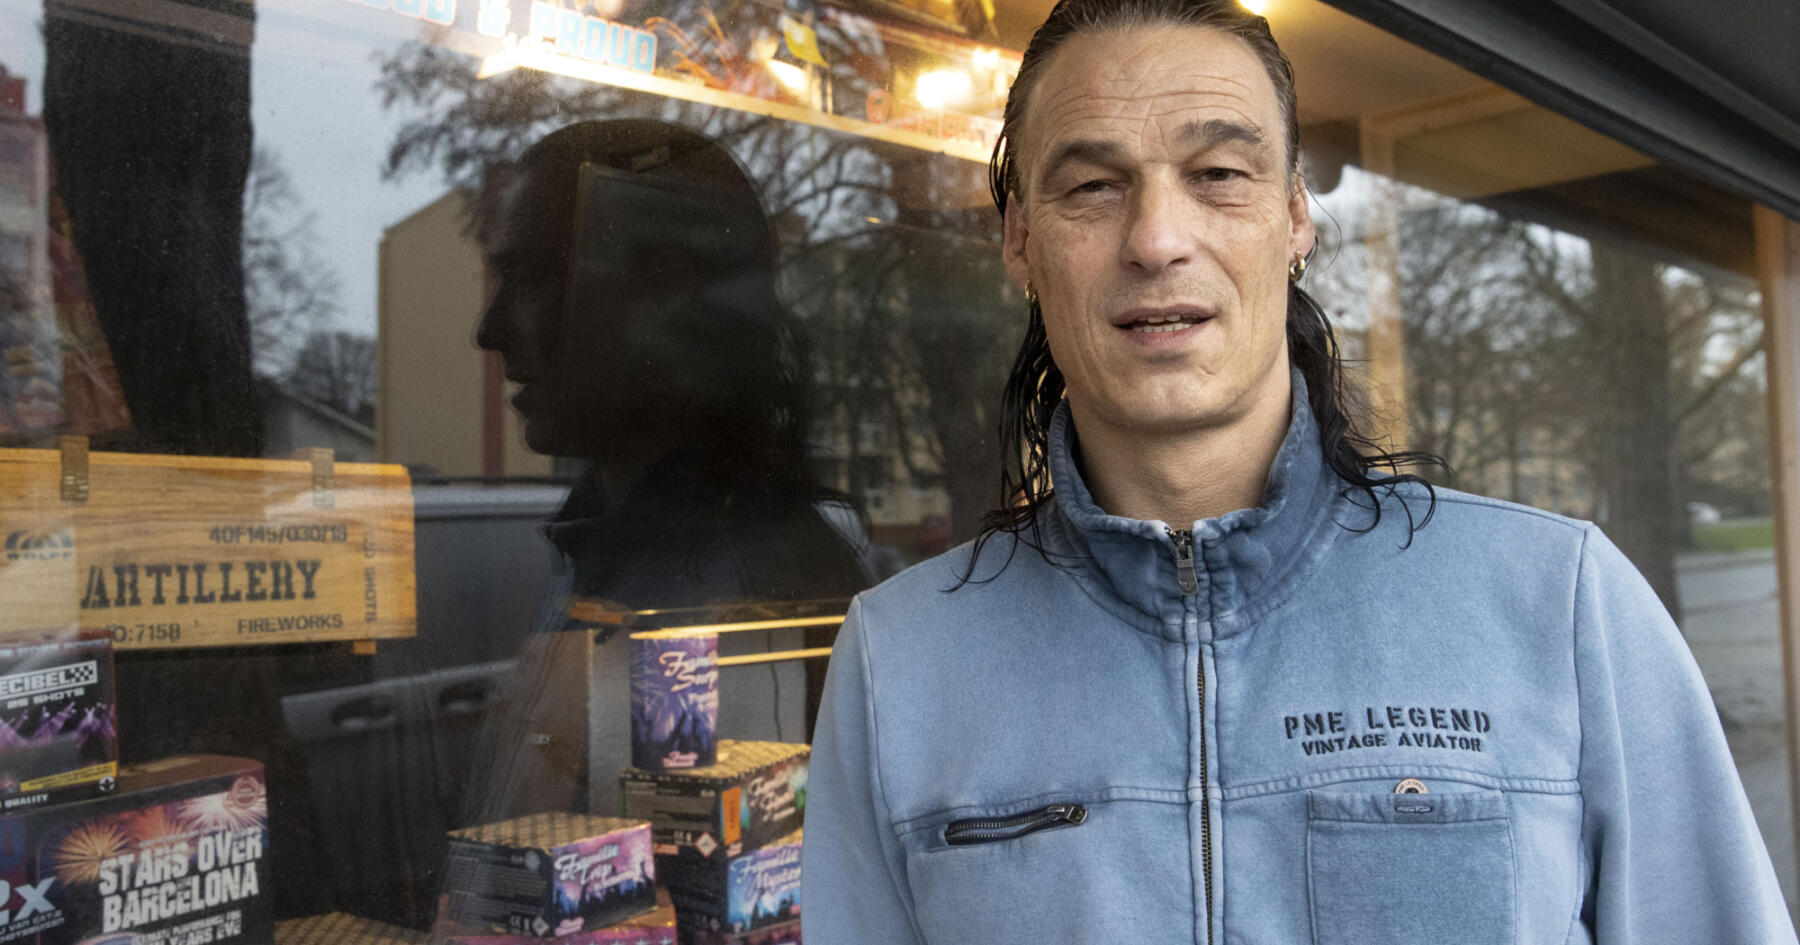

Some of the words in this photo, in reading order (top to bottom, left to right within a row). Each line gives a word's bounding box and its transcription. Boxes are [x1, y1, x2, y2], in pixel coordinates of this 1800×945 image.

[530, 2, 657, 73] PROUD
[81, 560, 321, 609] ARTILLERY
[237, 613, 343, 634] FIREWORKS
[1284, 712, 1345, 739] PME
[1366, 706, 1491, 733] LEGEND
[1301, 734, 1387, 756] VINTAGE
[1398, 733, 1482, 752] AVIATOR
[4, 793, 49, 808] QUALITY
[98, 842, 190, 896] STARS
[197, 826, 263, 872] OVER
[102, 862, 260, 934] BARCELONA
